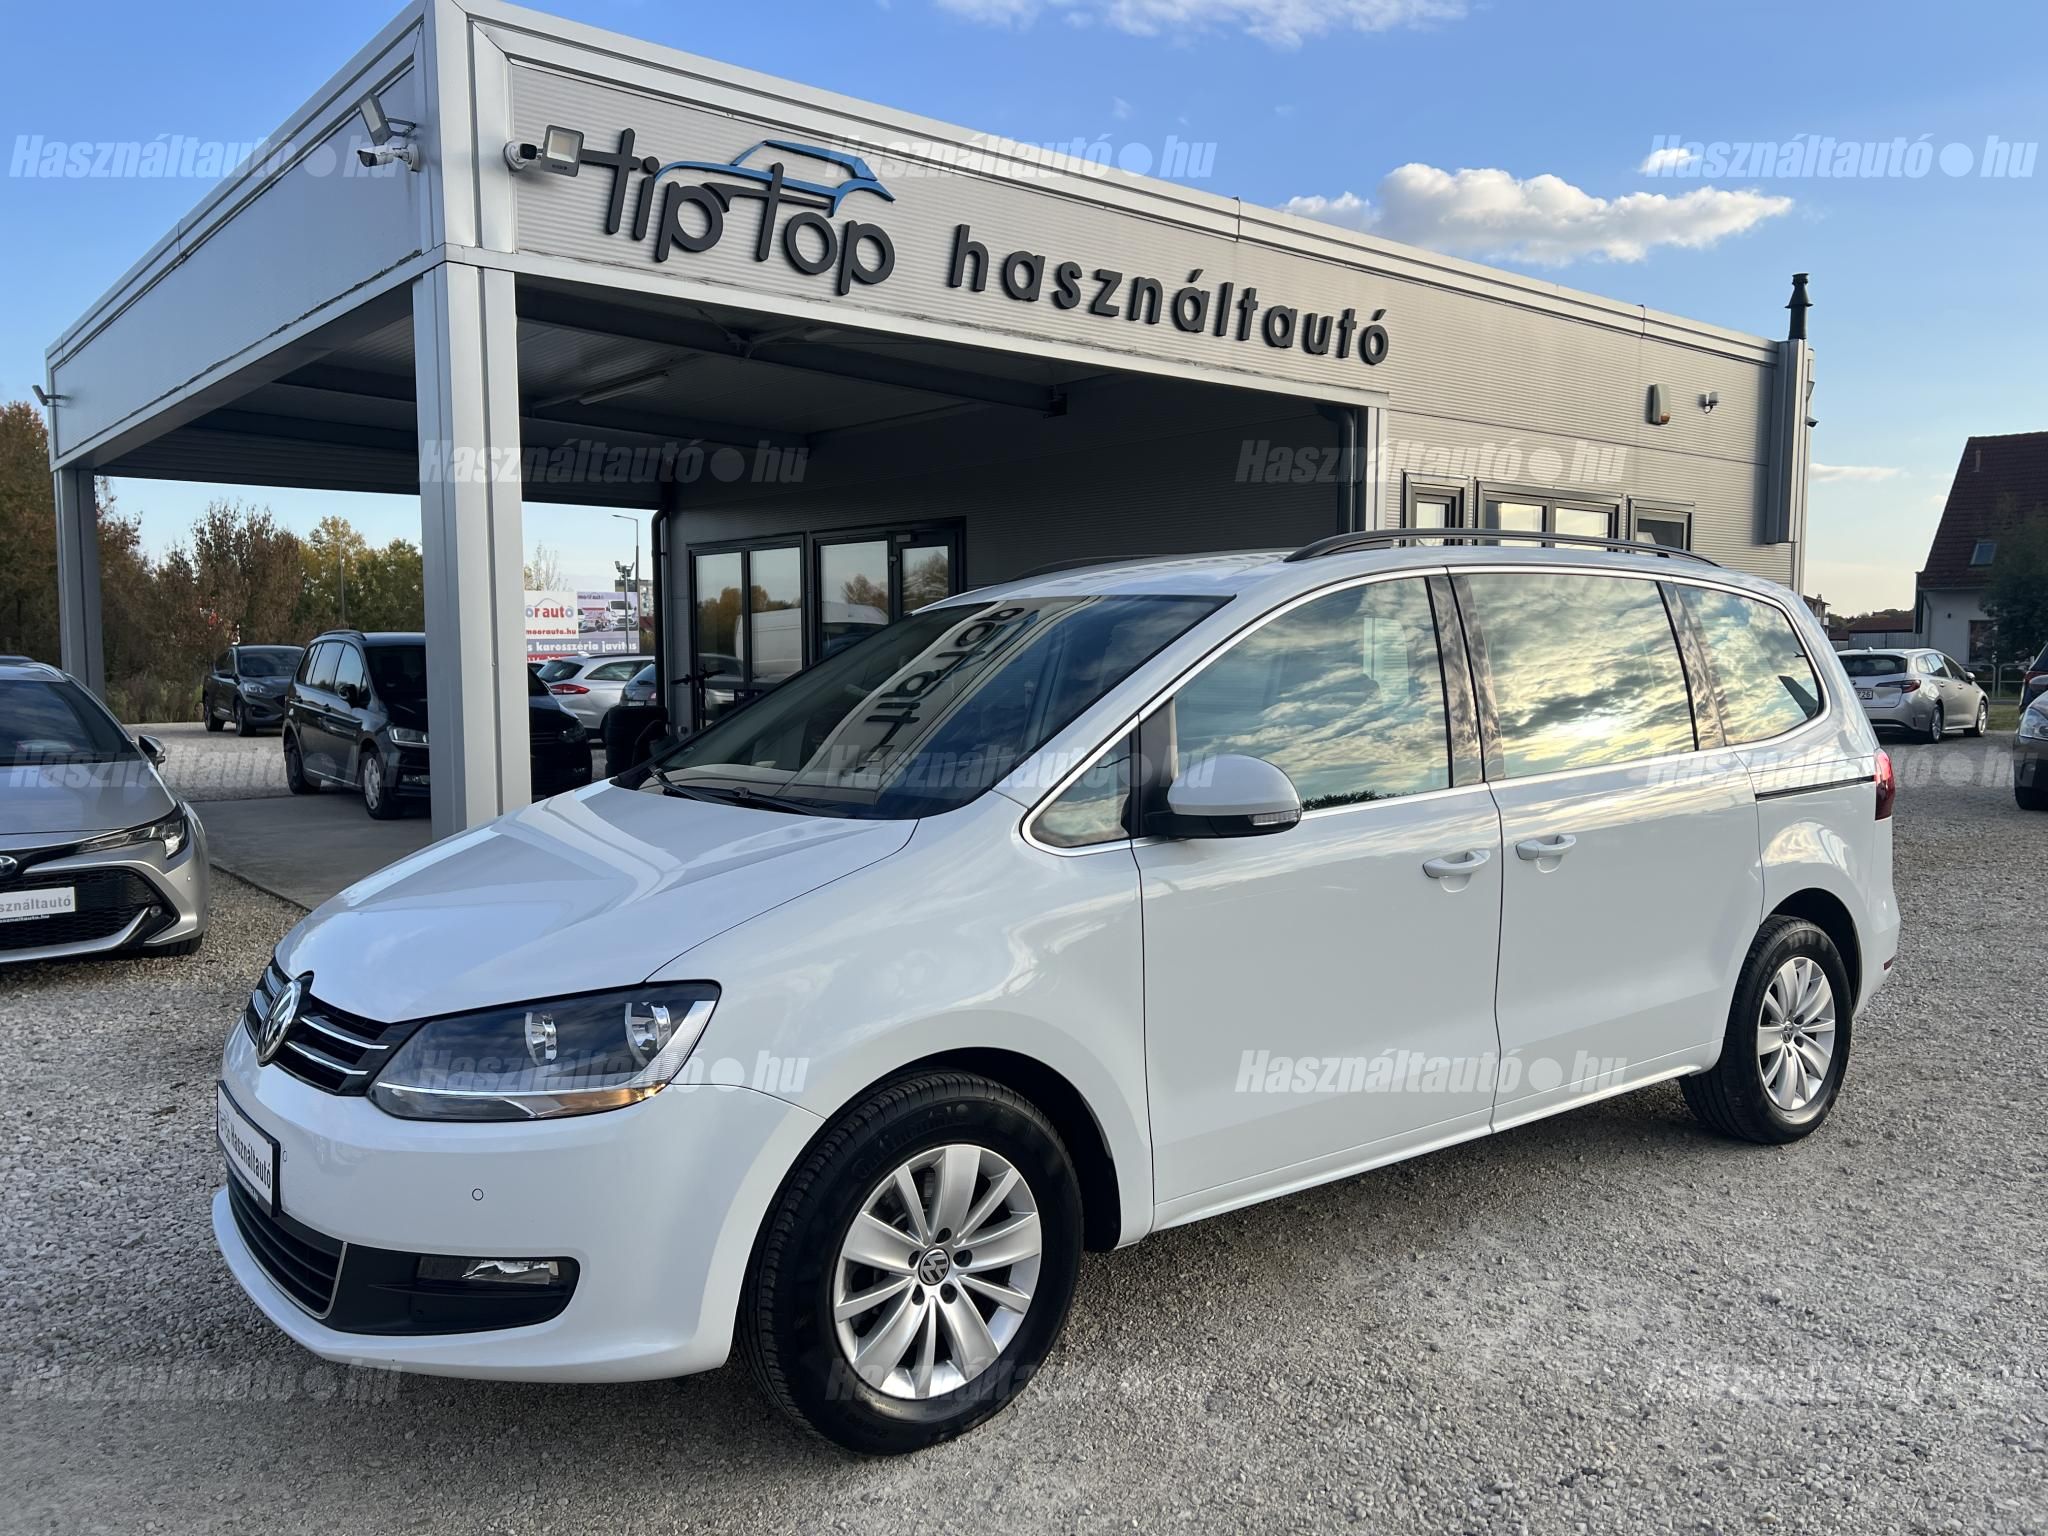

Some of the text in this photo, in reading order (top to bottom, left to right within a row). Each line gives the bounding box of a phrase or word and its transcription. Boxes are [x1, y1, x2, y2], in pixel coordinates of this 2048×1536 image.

[951, 223, 1391, 366] használtautó
[536, 641, 598, 653] karosszéria
[230, 1123, 271, 1190] Használtautó
